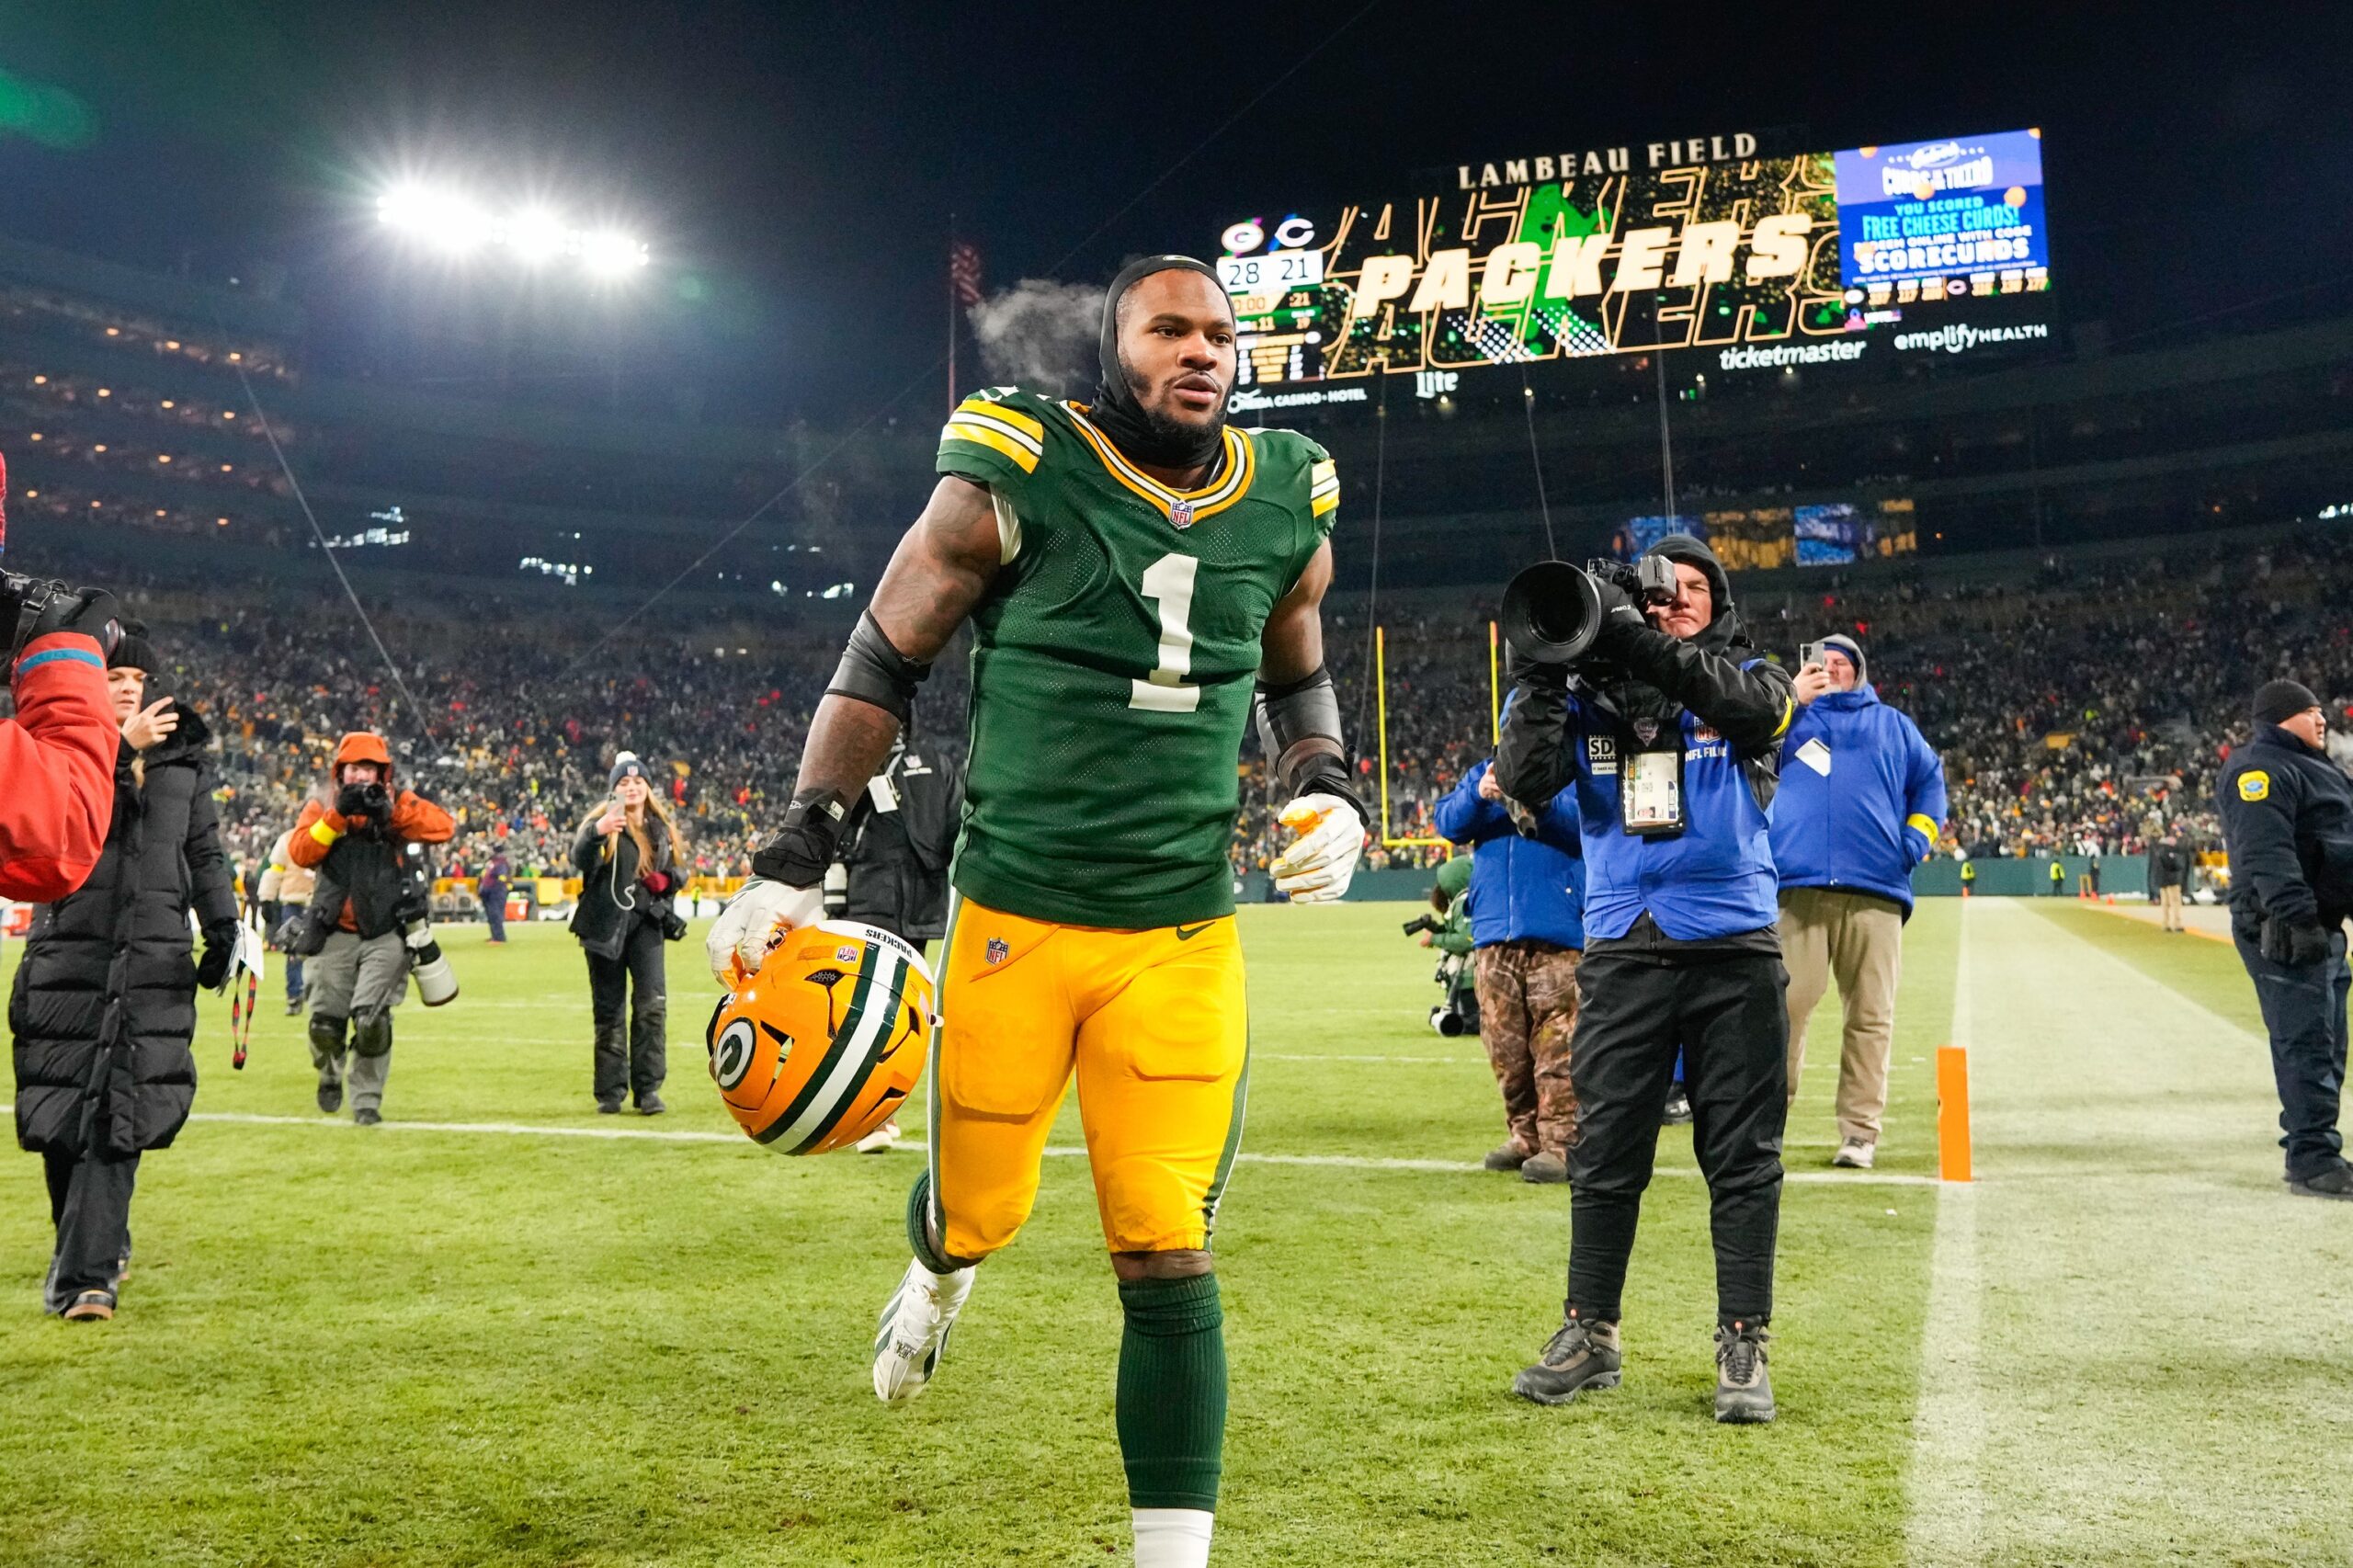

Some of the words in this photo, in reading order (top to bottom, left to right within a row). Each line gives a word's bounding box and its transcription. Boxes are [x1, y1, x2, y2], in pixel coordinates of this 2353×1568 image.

[1458, 147, 1630, 189] LAMBEAU
[1648, 133, 1756, 168] FIELD
[1894, 201, 1925, 217] YOU
[1927, 196, 1984, 214] SCORED
[1862, 214, 1900, 242] FREE
[1902, 210, 1960, 238] CHEESE
[1961, 203, 2020, 232] CURDS!
[1907, 232, 1956, 248] ONLINE
[1958, 229, 1993, 244] WITH
[1995, 224, 2032, 241] CODE
[1229, 261, 1260, 286] 28
[1280, 256, 1309, 280] 21
[1351, 213, 1813, 319] PACKERS
[1894, 324, 1978, 353] emplify
[1979, 324, 2048, 342] HEALTH
[1719, 339, 1867, 369] ticketmaster
[1274, 392, 1322, 407] CASINO
[1328, 388, 1368, 403] HOTEL
[1415, 371, 1460, 399] Lite
[1173, 511, 1188, 524] NFL
[1129, 552, 1199, 712] 1
[1590, 739, 1613, 756] SD
[1685, 748, 1703, 762] NFL
[865, 928, 913, 959] PACKERS
